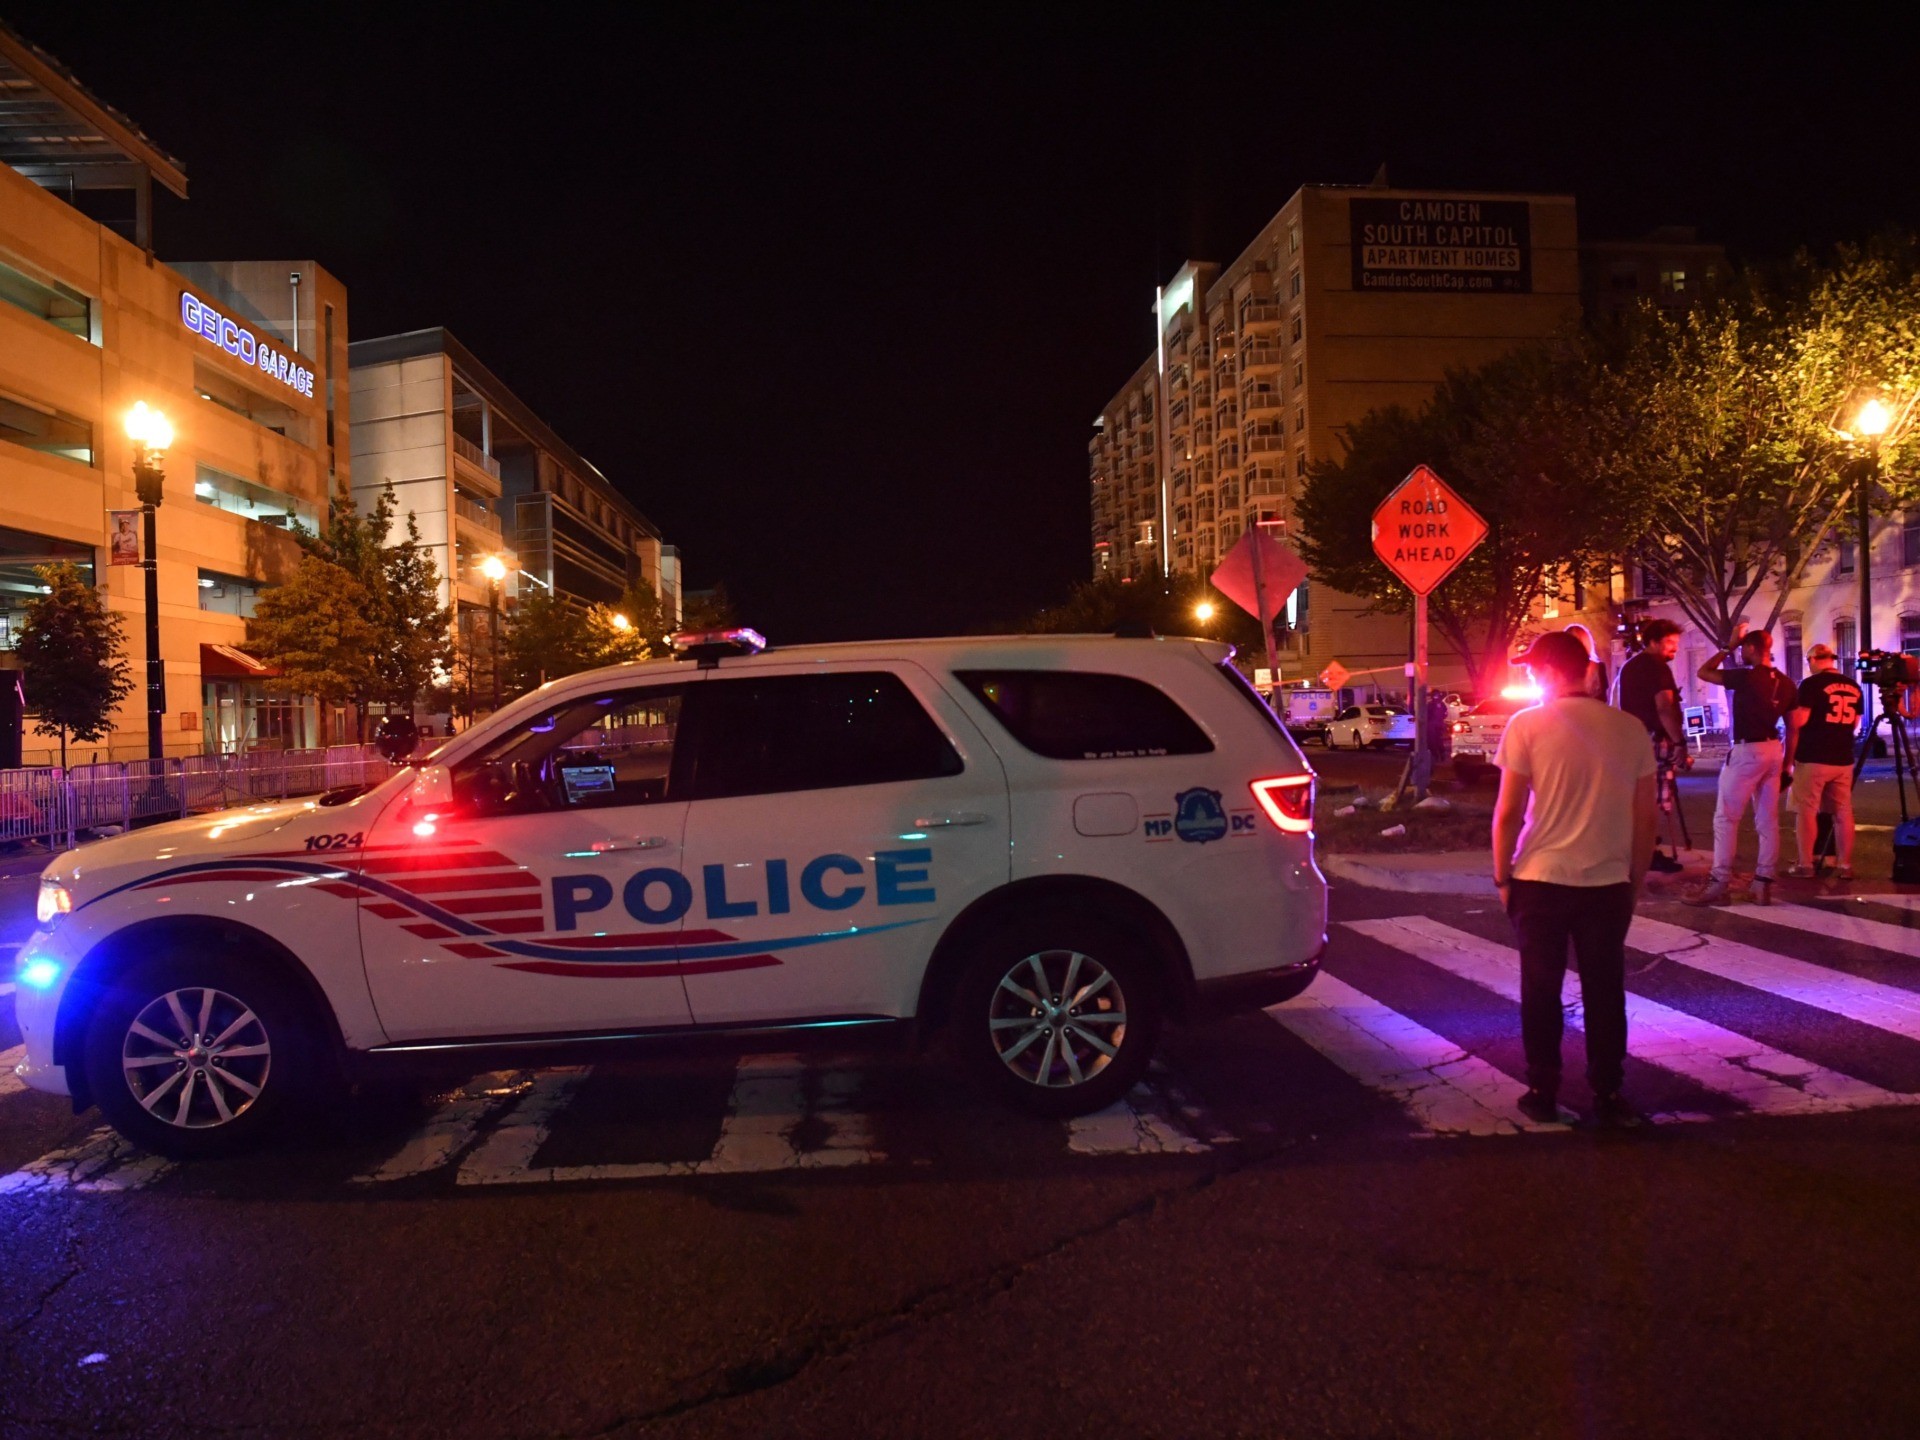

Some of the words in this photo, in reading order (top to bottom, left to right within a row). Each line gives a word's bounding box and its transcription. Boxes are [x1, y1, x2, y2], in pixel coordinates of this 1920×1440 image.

[1400, 202, 1481, 222] CAMDEN
[1363, 224, 1428, 244] SOUTH
[1436, 226, 1518, 246] CAPITOL
[1367, 249, 1459, 266] APARTMENT
[1464, 250, 1516, 267] HOMES
[1362, 271, 1493, 290] CamdenSouthCap.com
[181, 291, 256, 366] GEICO
[258, 343, 314, 399] GARAGE
[1401, 499, 1448, 515] ROAD
[1398, 523, 1449, 539] WORK
[1394, 547, 1456, 562] AHEAD
[1293, 692, 1332, 700] POLICE
[1825, 694, 1858, 725] 35
[1144, 819, 1172, 836] MP
[1231, 814, 1255, 830] DC
[304, 832, 364, 851] 1024
[552, 847, 937, 931] POLICE
